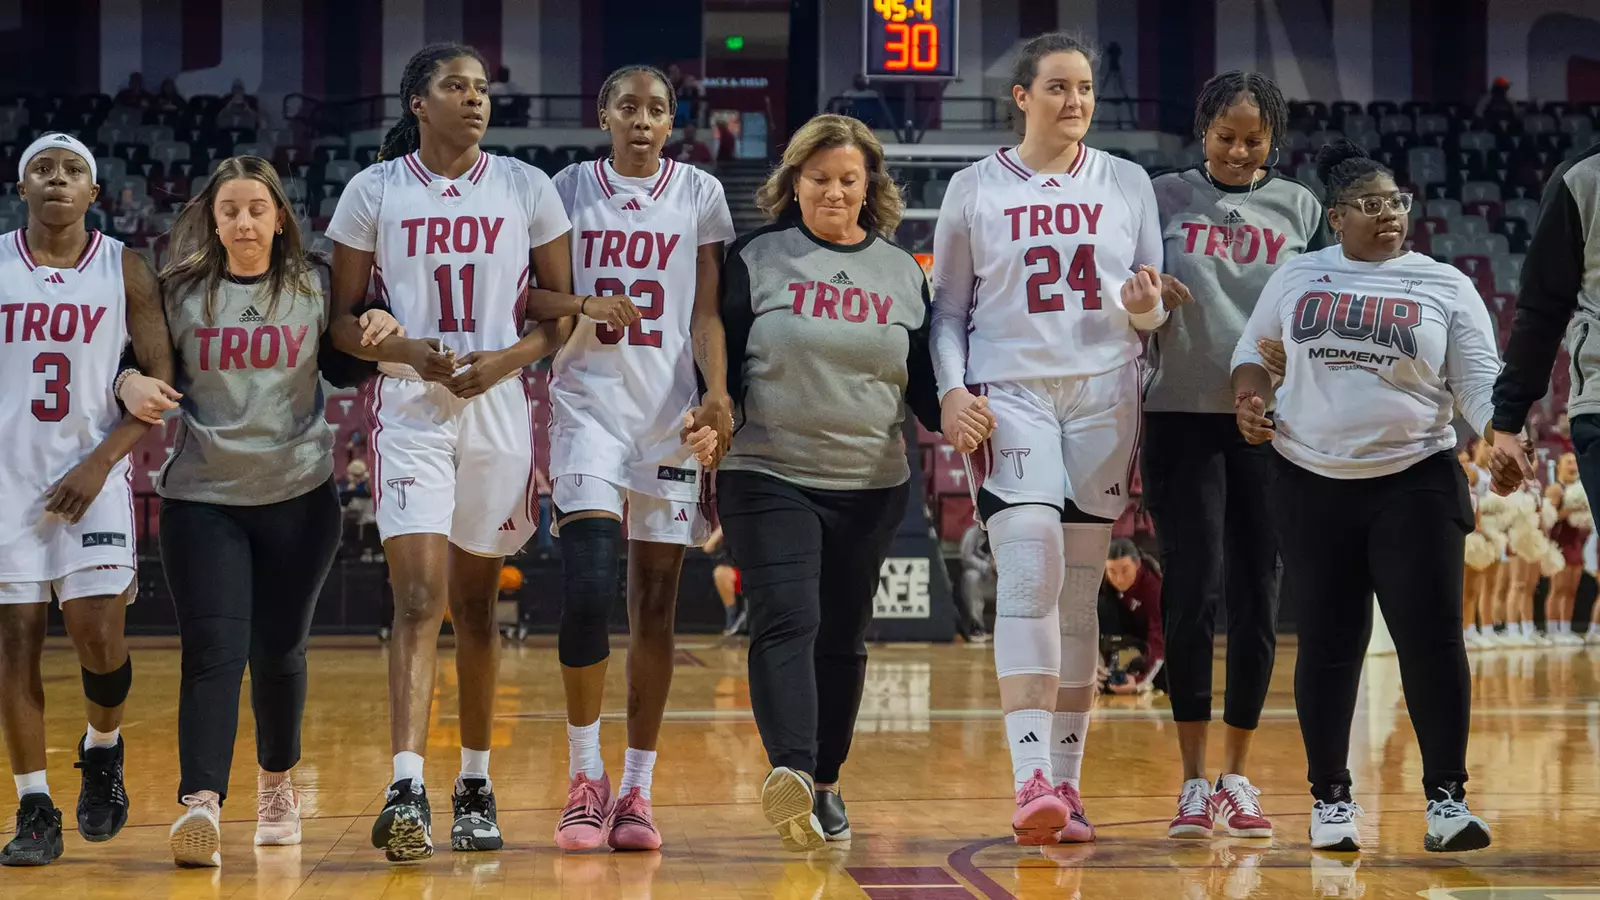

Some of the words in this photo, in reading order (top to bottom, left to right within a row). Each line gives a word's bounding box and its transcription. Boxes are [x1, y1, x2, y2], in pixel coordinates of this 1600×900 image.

[883, 22, 939, 71] 30
[401, 215, 505, 258] TROY
[1004, 203, 1103, 241] TROY
[1181, 222, 1286, 265] TROY
[581, 230, 681, 271] TROY
[434, 263, 477, 333] 11
[1024, 244, 1102, 314] 24
[0, 302, 107, 344] TROY
[788, 280, 893, 325] TROY
[1290, 290, 1423, 360] OUR
[194, 325, 309, 371] TROY
[1308, 347, 1400, 367] MOMENT
[31, 352, 71, 422] 3
